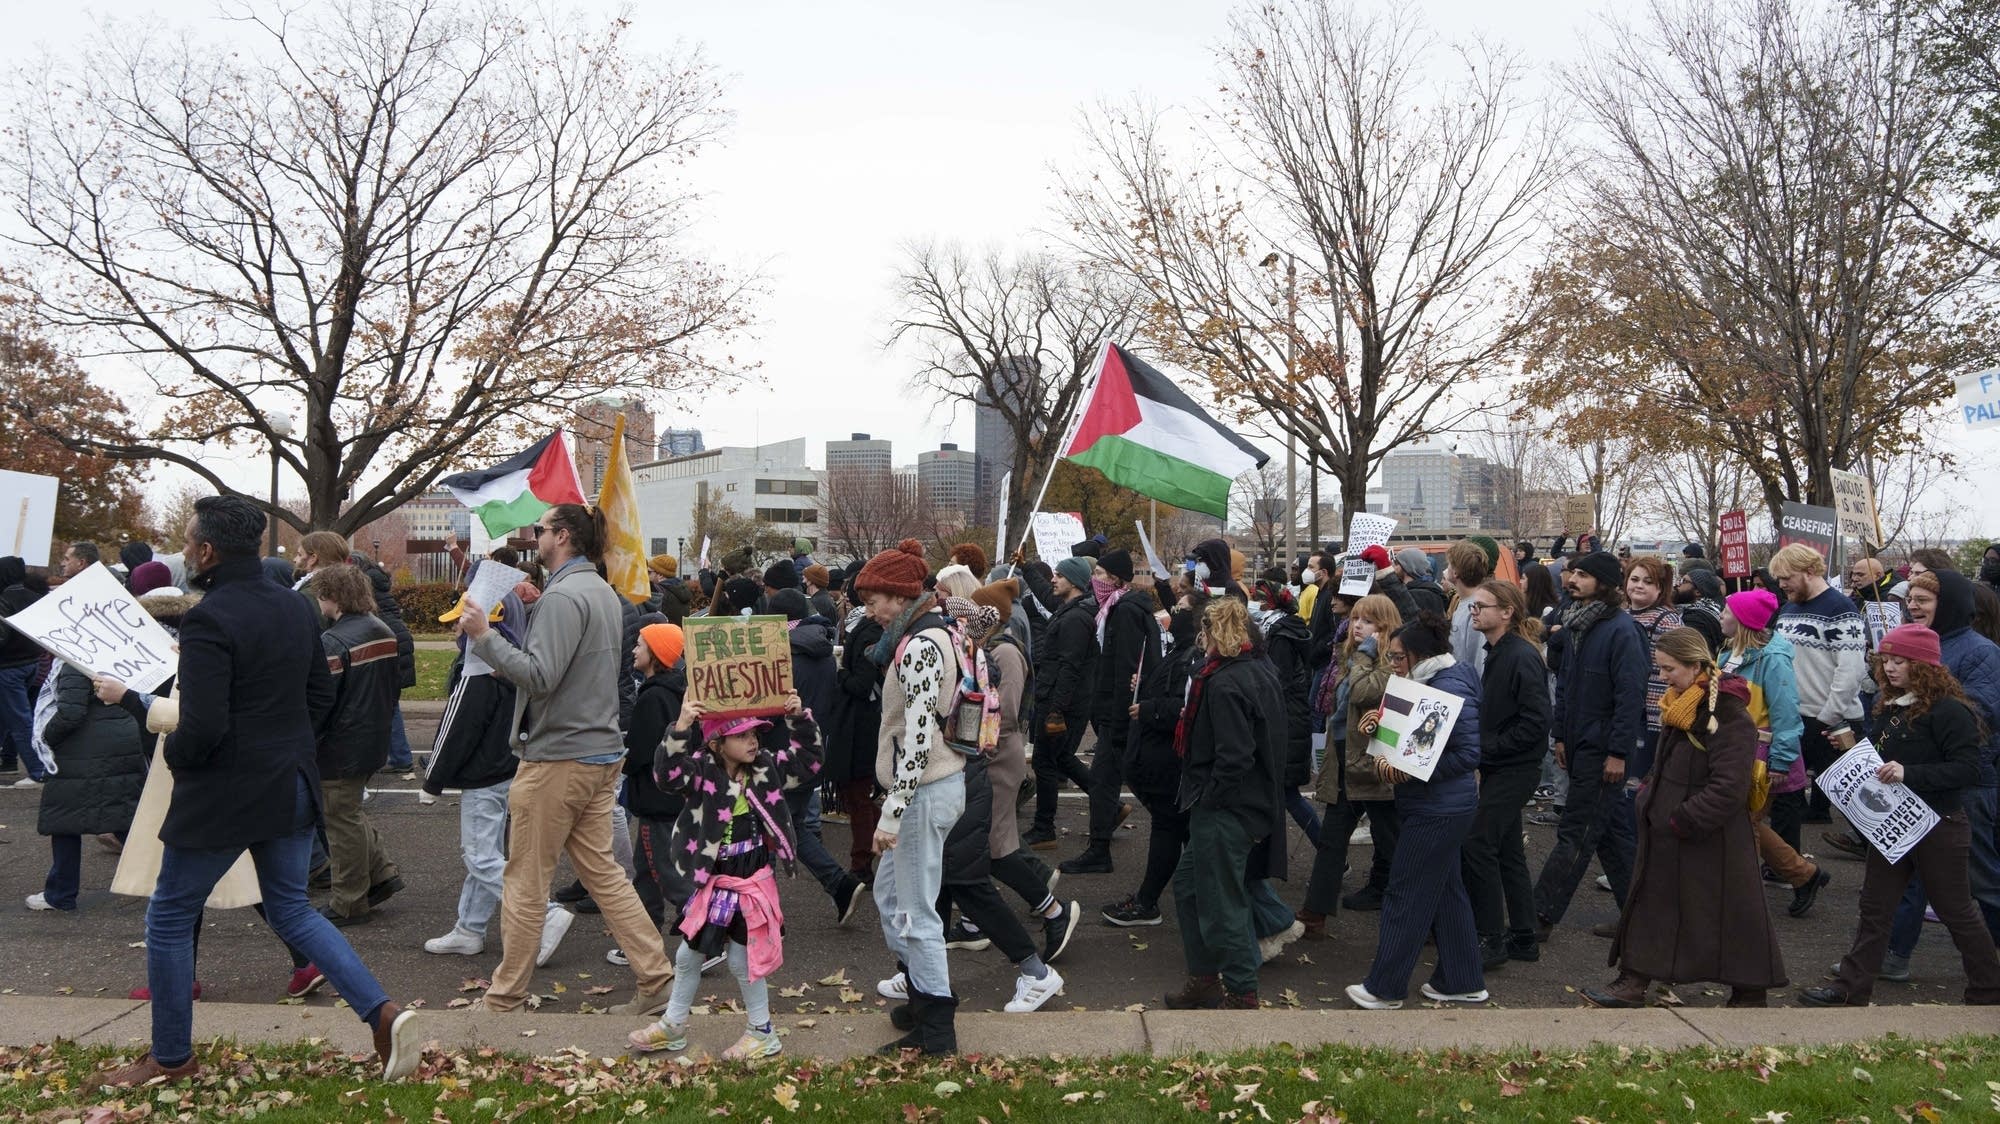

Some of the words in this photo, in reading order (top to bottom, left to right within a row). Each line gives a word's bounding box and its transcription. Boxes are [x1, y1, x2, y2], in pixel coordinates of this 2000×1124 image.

[1980, 373, 2000, 394] F
[1964, 400, 2000, 424] PAL
[1842, 498, 1850, 513] IS
[1853, 501, 1867, 516] NOT
[1723, 518, 1733, 530] END
[1782, 515, 1833, 537] CEASEFIRE
[1722, 530, 1746, 546] MILITARY
[1726, 546, 1736, 560] AID
[1736, 545, 1745, 559] TO
[1727, 560, 1747, 574] ISRAEL
[694, 627, 766, 662] FREE
[1839, 763, 1863, 789] STOP
[1841, 766, 1880, 807] SUPPORTING
[1872, 796, 1916, 841] APARTHEID
[1879, 804, 1926, 850] ISRAEL!
